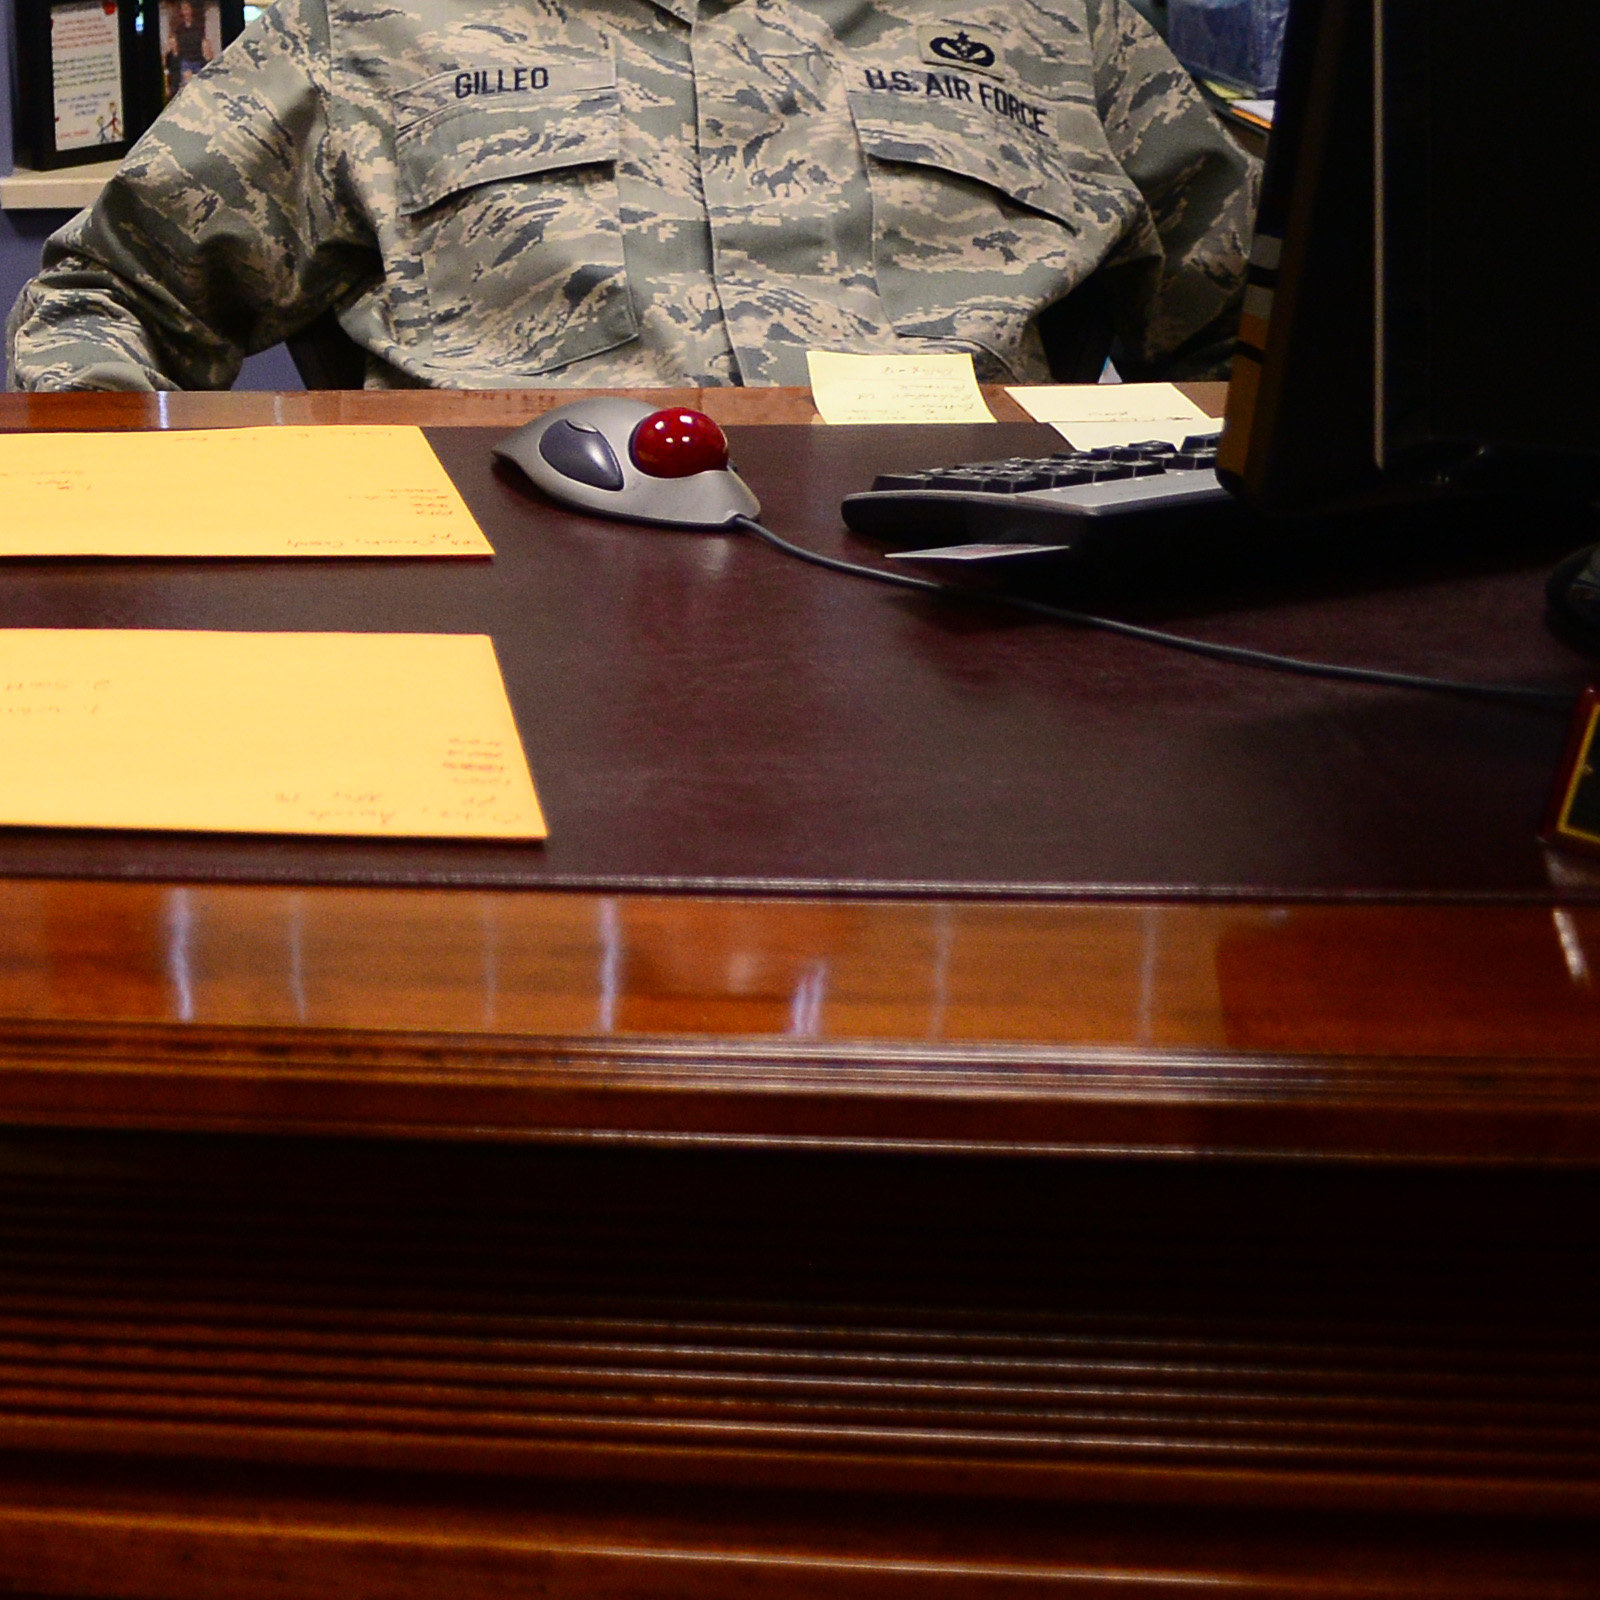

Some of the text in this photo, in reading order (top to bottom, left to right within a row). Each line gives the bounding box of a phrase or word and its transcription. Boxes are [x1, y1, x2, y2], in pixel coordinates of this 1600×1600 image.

[453, 64, 550, 100] GILLEO
[863, 66, 1050, 136] U.S. AIR FORCE
